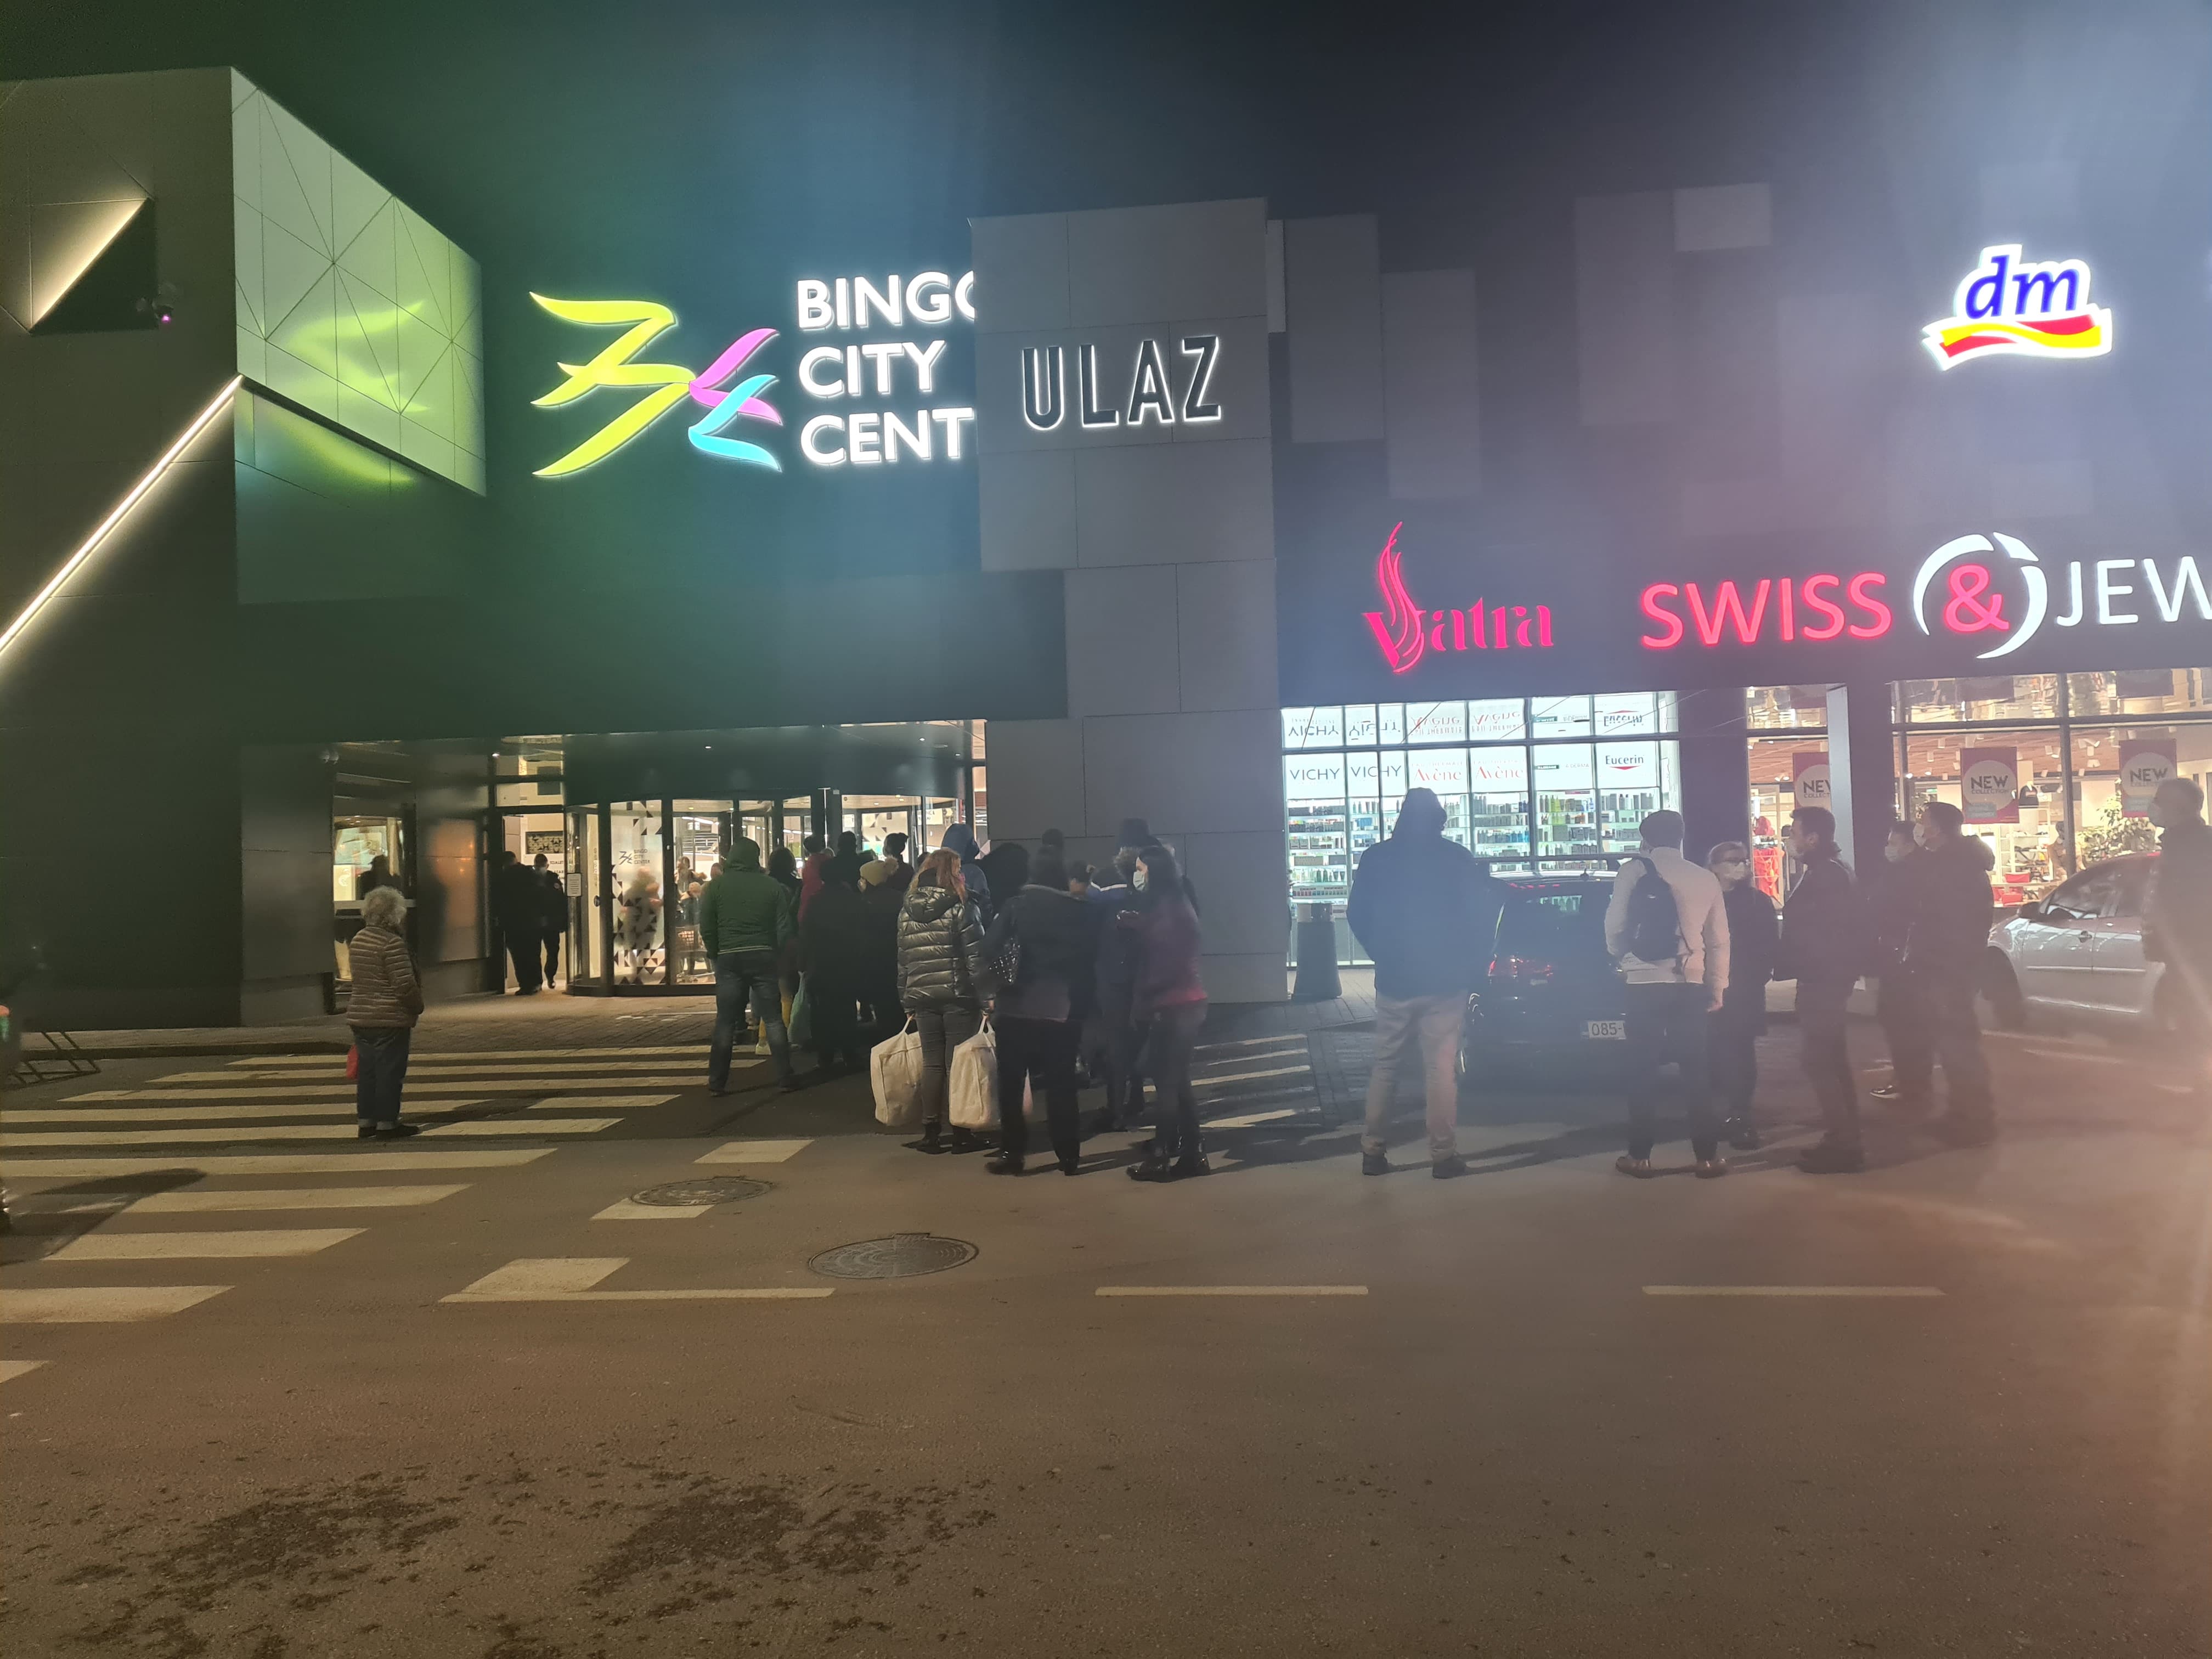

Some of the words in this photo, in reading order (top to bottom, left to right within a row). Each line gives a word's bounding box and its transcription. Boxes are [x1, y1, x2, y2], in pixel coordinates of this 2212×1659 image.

[1966, 255, 2080, 319] dm
[798, 340, 946, 398] CITY
[1022, 335, 1221, 431] ULAZ
[800, 407, 974, 465] CENT
[1641, 572, 1893, 649] SWISS
[1943, 563, 2010, 633] &
[1290, 768, 1340, 781] VICHY
[1414, 769, 1462, 781] Avène
[1605, 754, 1644, 765] Eucerin
[2130, 768, 2168, 782] NEW
[1971, 775, 2008, 789] NEW
